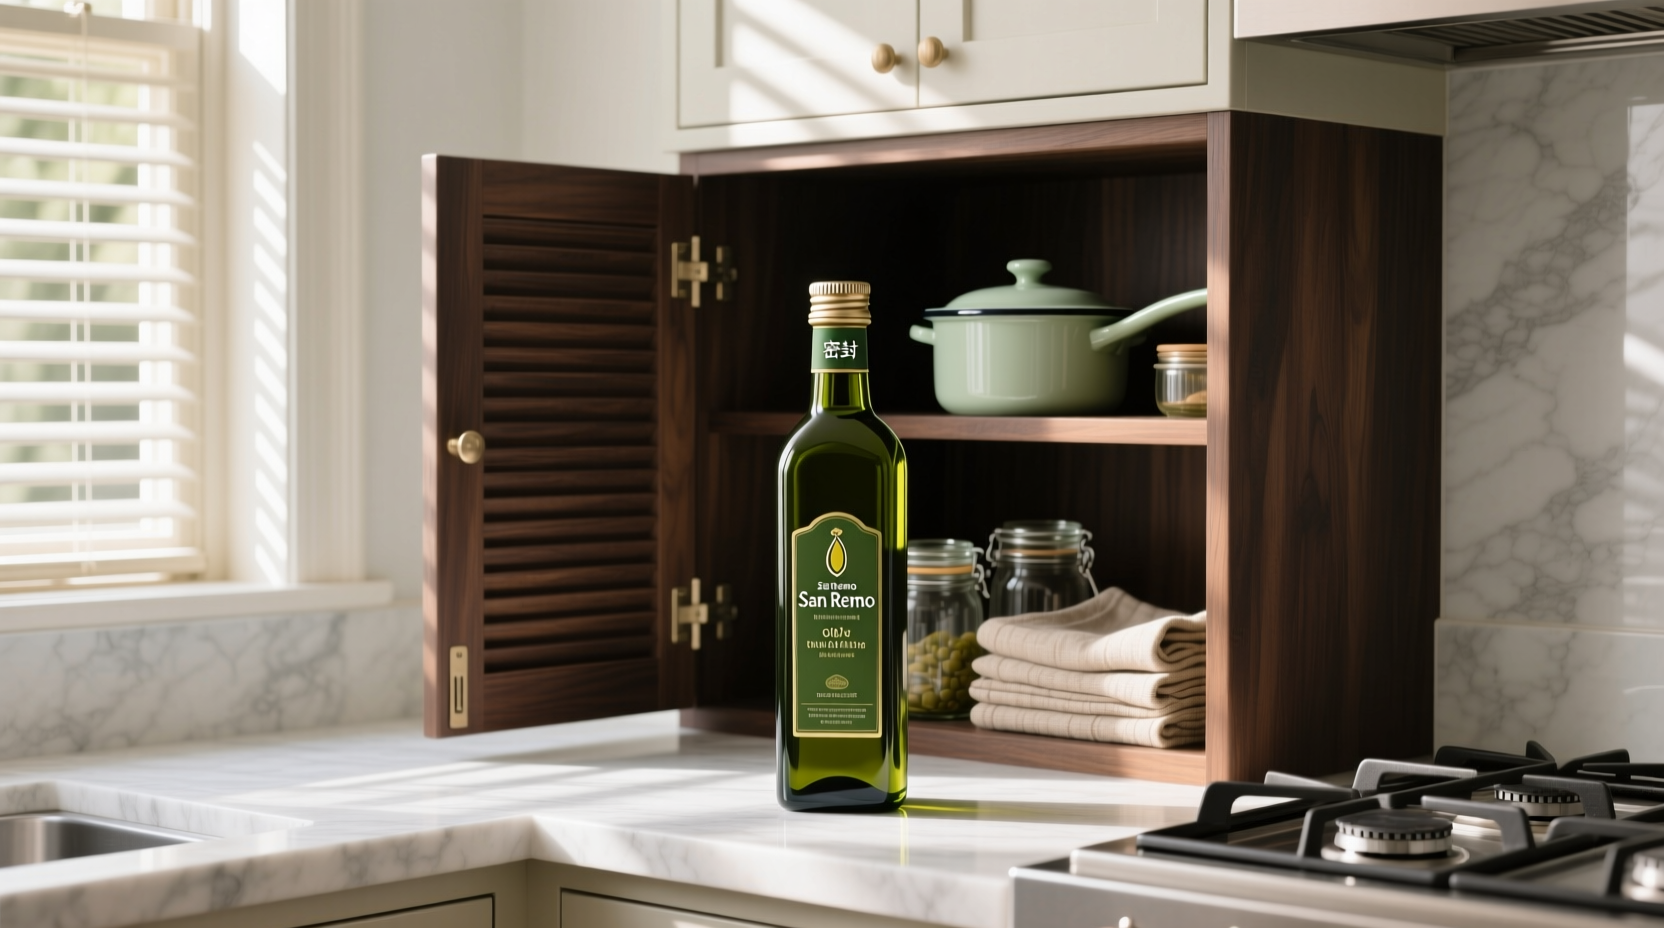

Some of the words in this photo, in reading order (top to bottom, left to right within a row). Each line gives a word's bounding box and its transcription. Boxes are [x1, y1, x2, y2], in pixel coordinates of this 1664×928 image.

[823, 339, 859, 360] 密封
[798, 591, 827, 608] San
[830, 591, 875, 608] Remo
